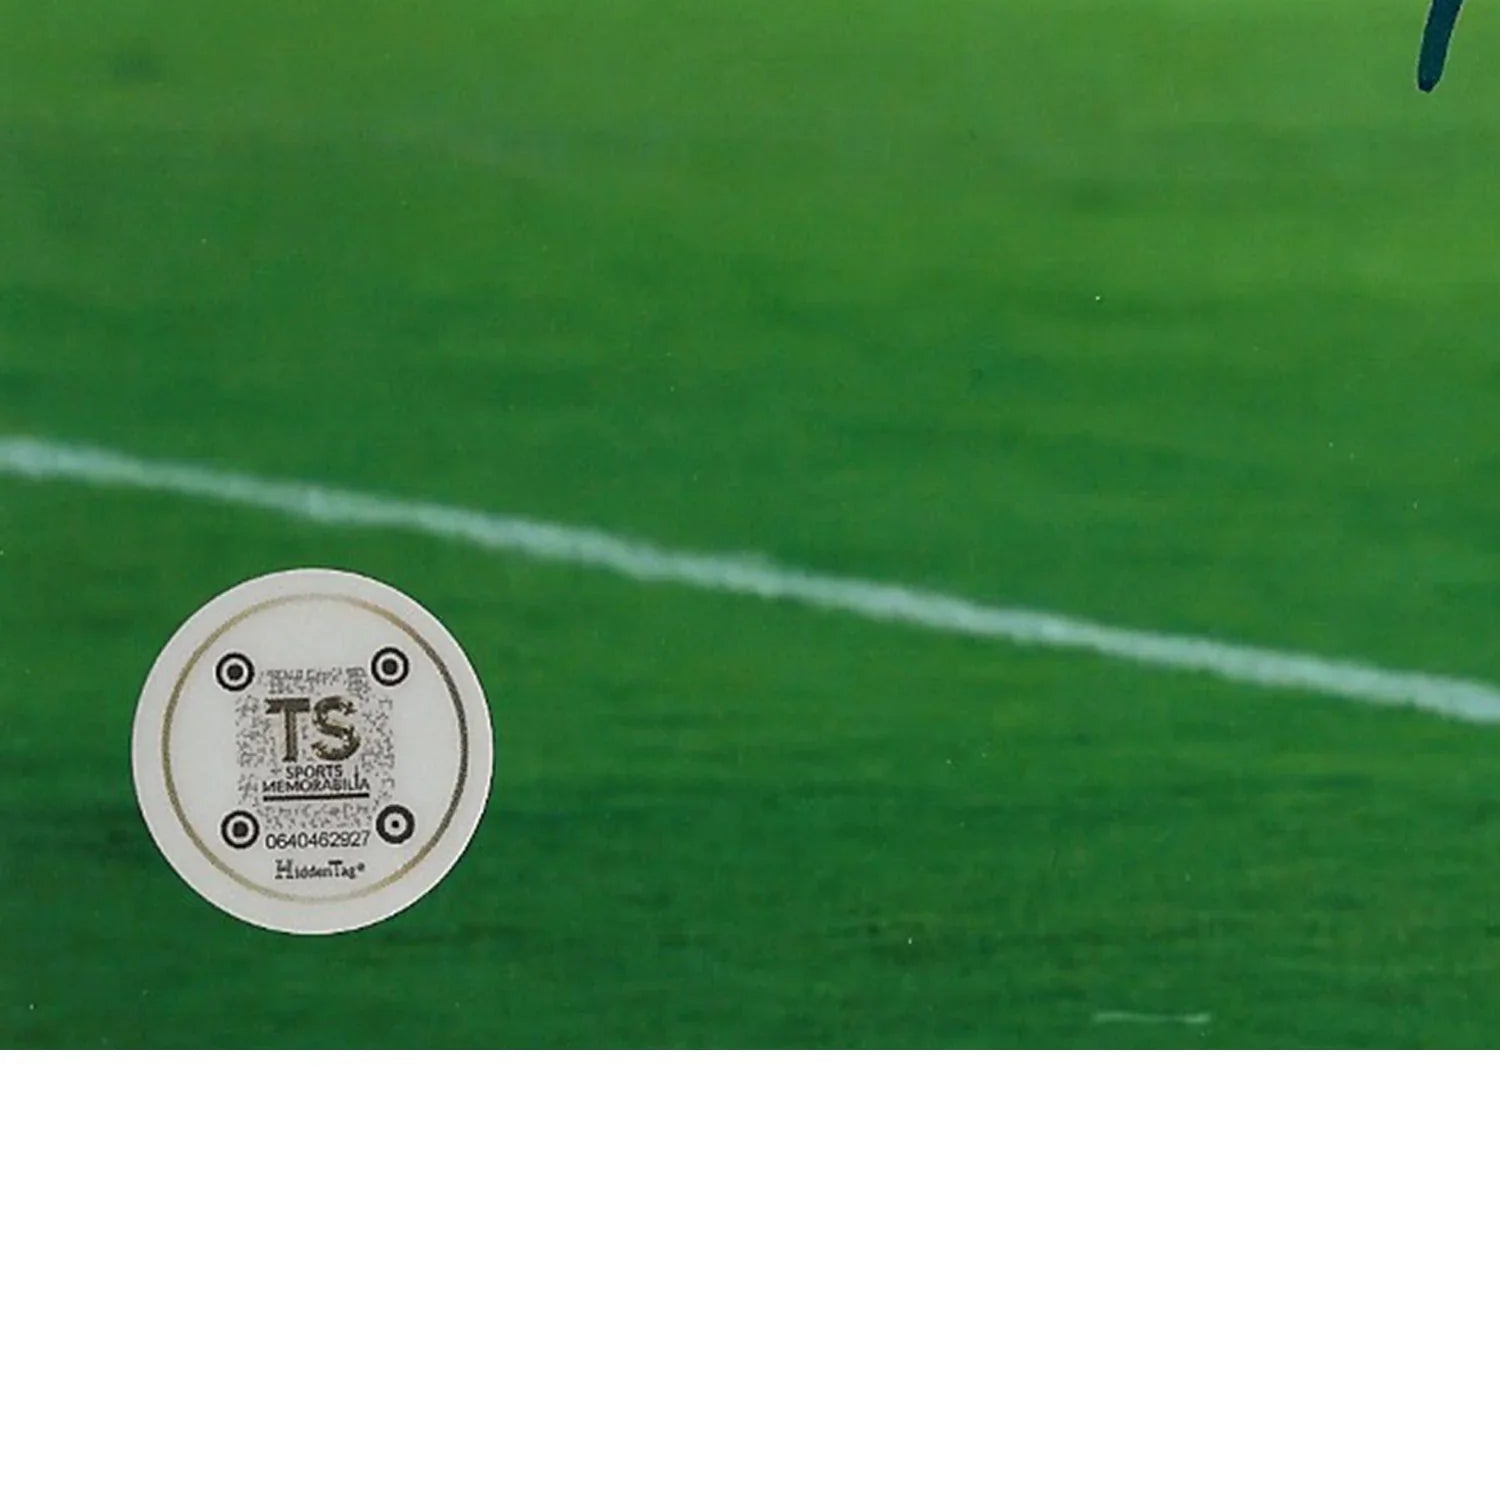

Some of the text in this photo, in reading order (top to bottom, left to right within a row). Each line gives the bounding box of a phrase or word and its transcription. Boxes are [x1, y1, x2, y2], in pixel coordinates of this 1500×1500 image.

[264, 695, 361, 763] TS
[262, 768, 370, 793] MEMORABILIA
[286, 764, 343, 780] SPORTS
